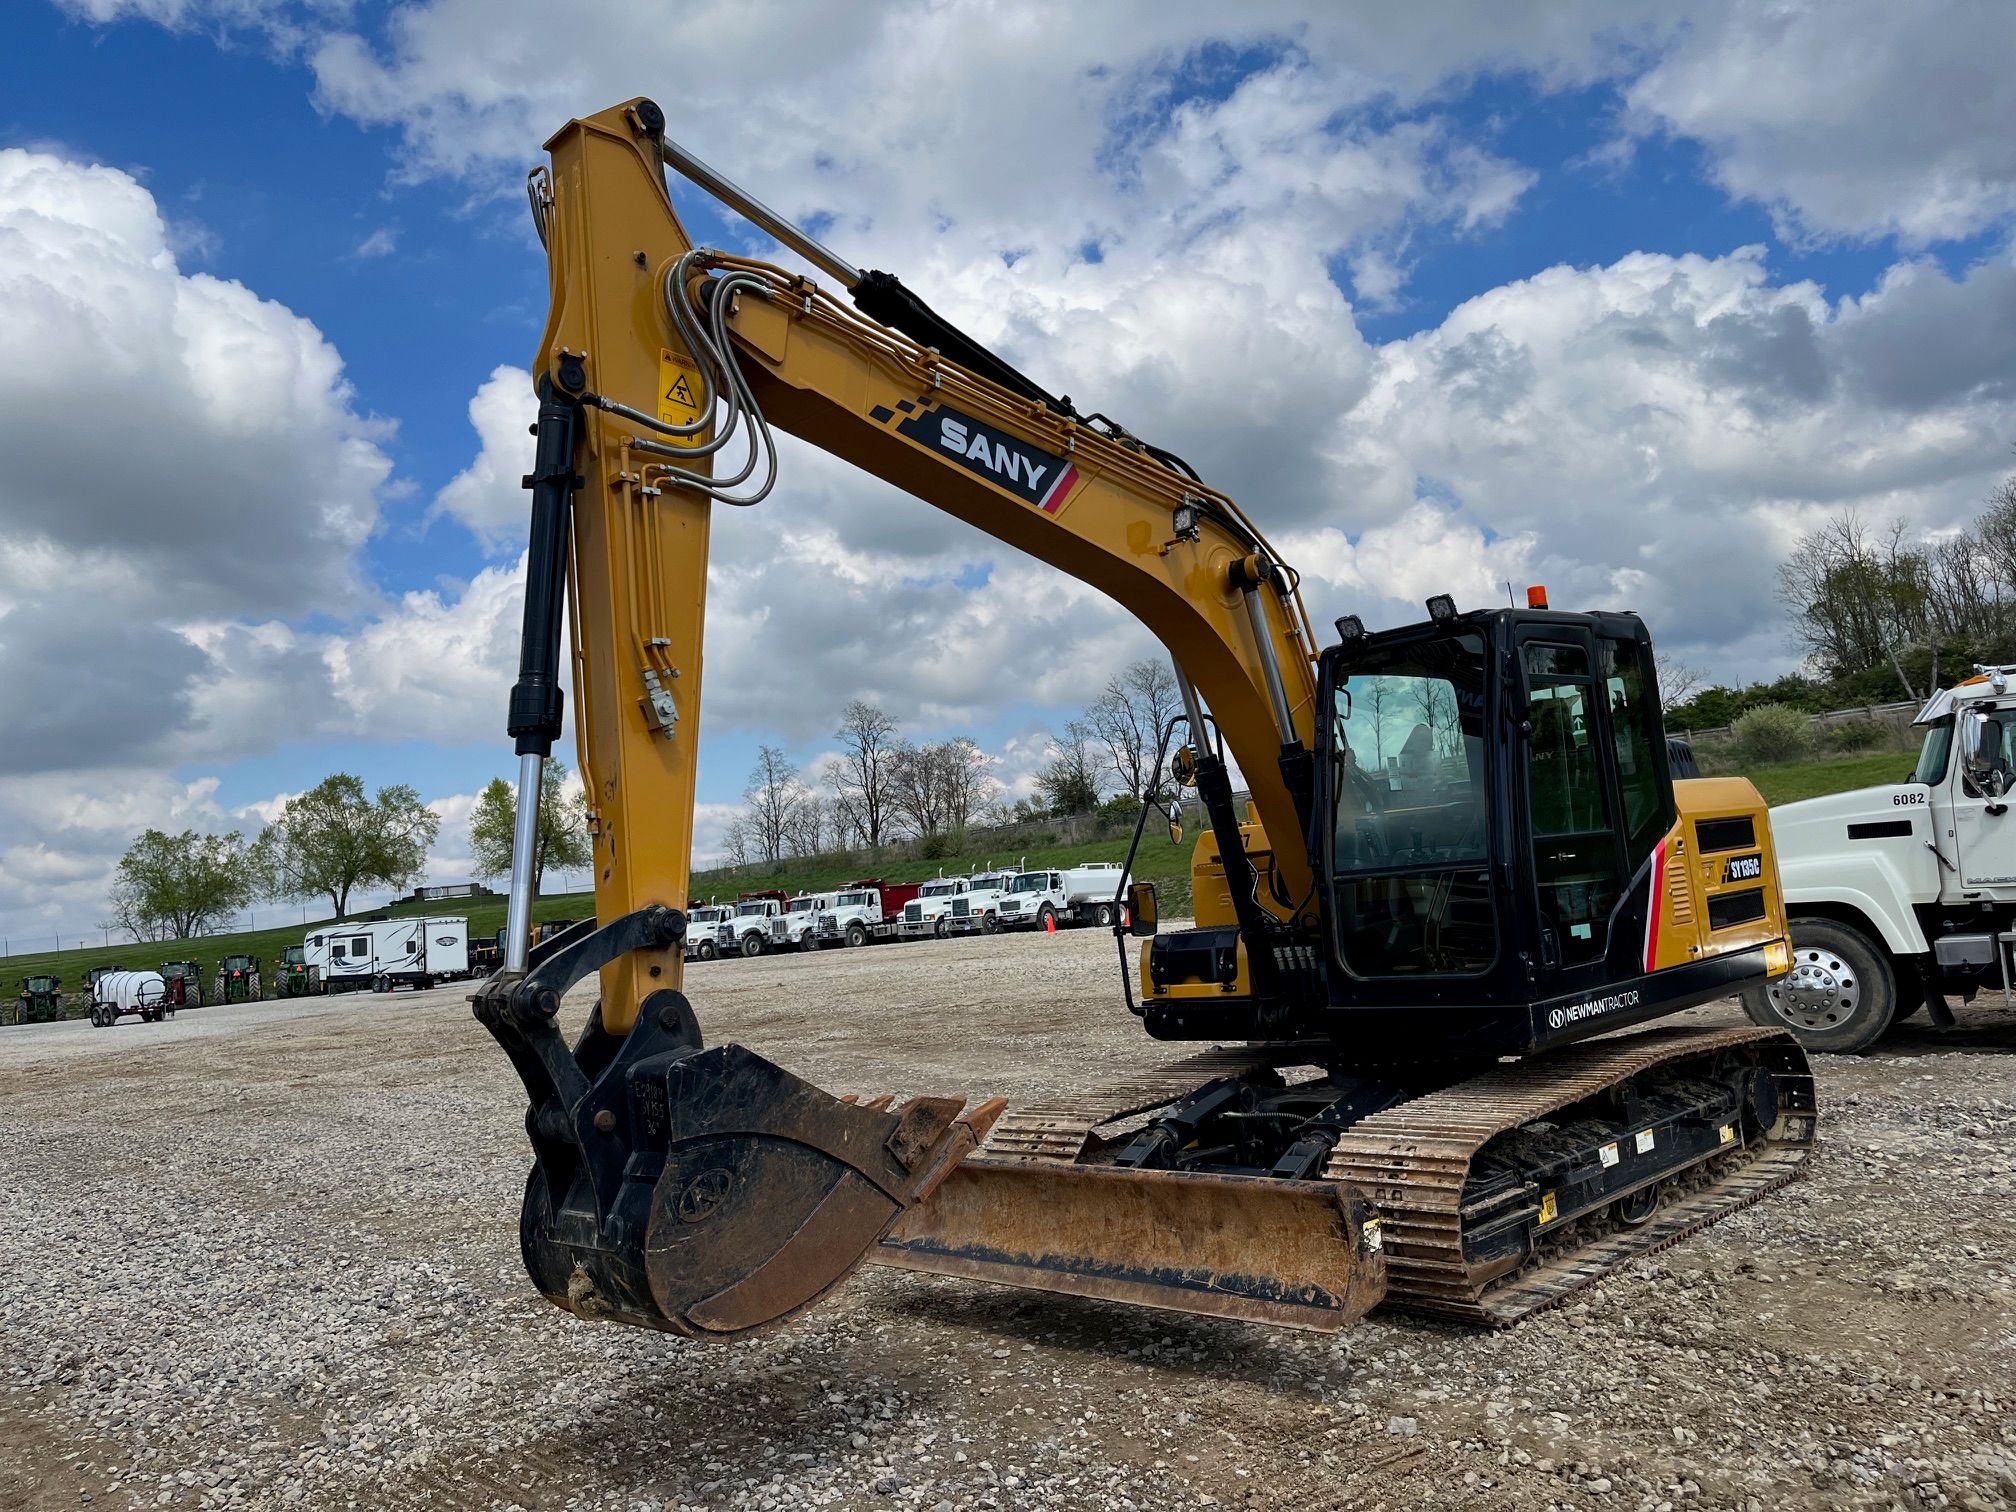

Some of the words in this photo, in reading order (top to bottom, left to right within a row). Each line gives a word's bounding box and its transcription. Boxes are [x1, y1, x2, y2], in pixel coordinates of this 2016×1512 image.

[941, 417, 1047, 491] SANY
[1893, 793, 1925, 806] 6082
[1731, 858, 1760, 878] SY135C
